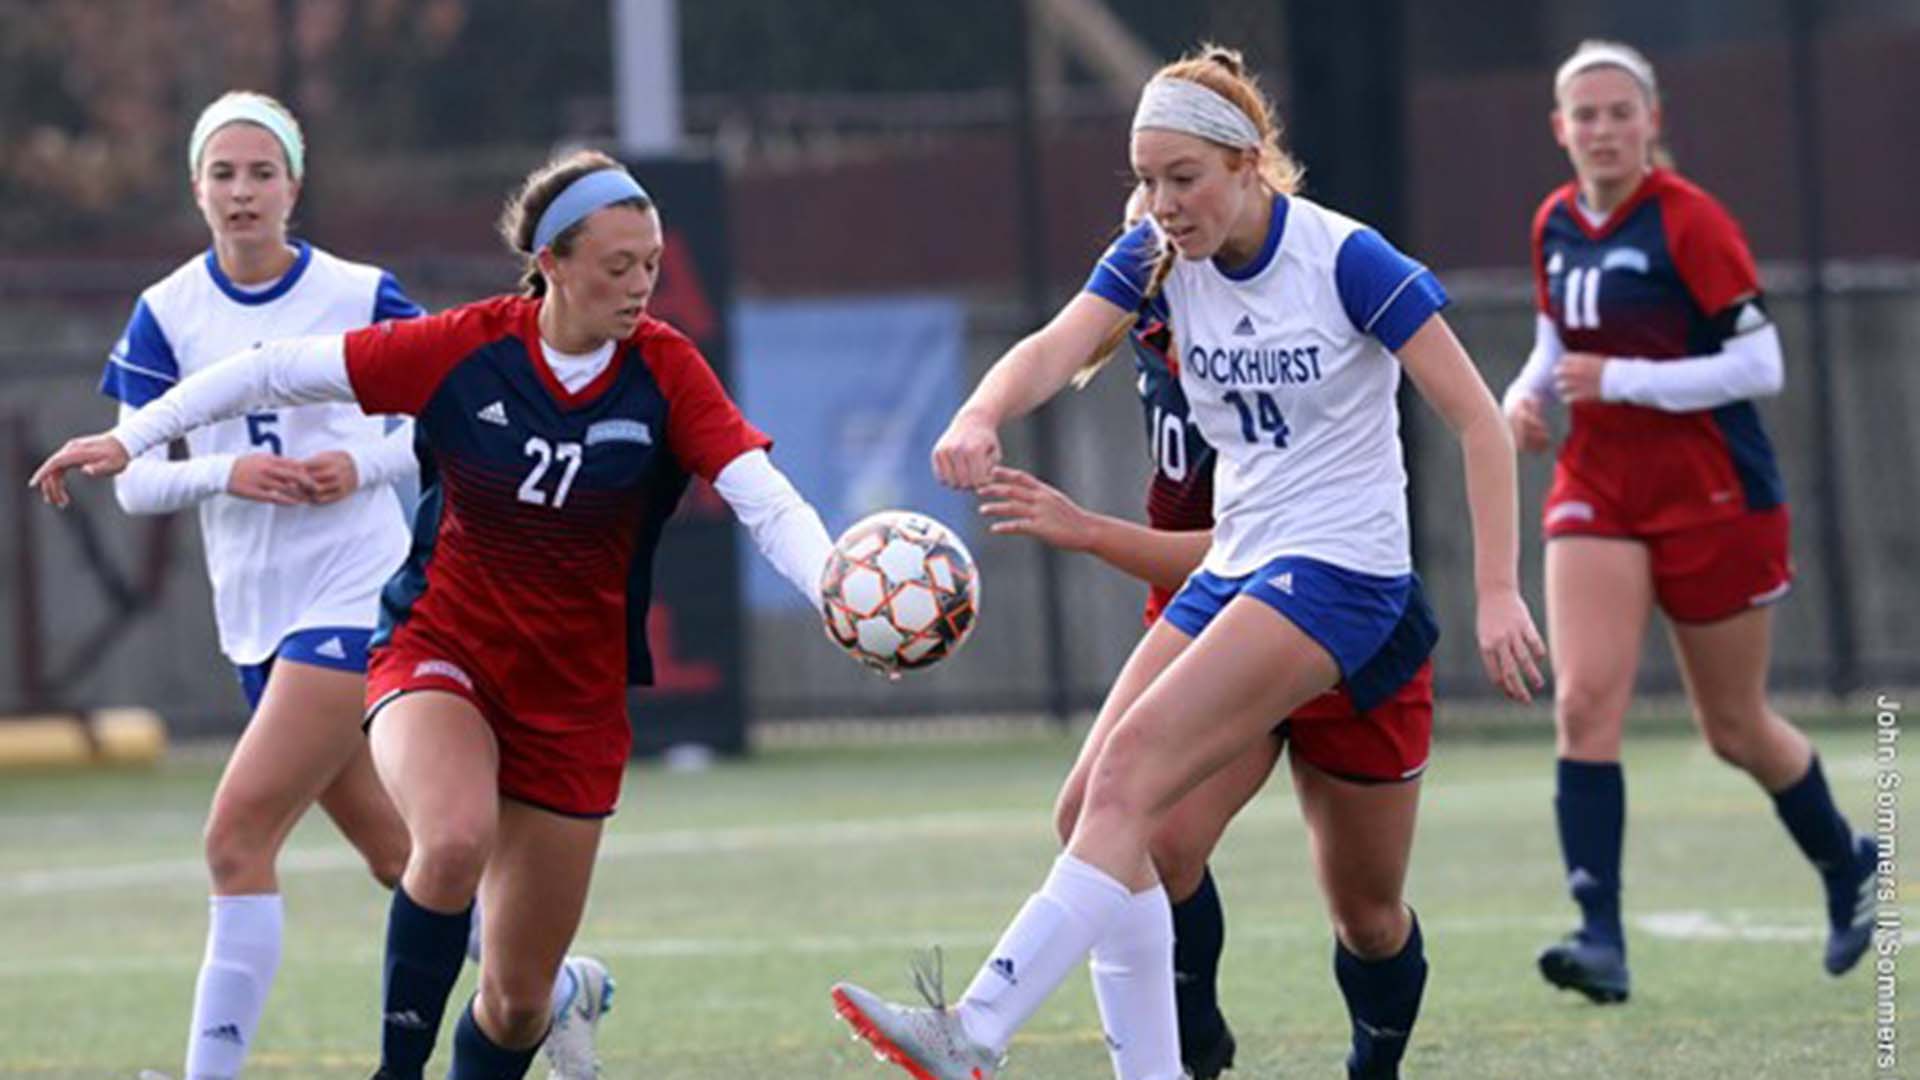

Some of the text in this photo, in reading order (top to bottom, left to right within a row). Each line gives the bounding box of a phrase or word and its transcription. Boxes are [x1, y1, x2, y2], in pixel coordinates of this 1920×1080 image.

[1565, 267, 1600, 329] 11
[1186, 345, 1322, 384] OCKHURST
[246, 413, 283, 457] 5
[1222, 389, 1291, 449] 14
[516, 436, 583, 509] 27
